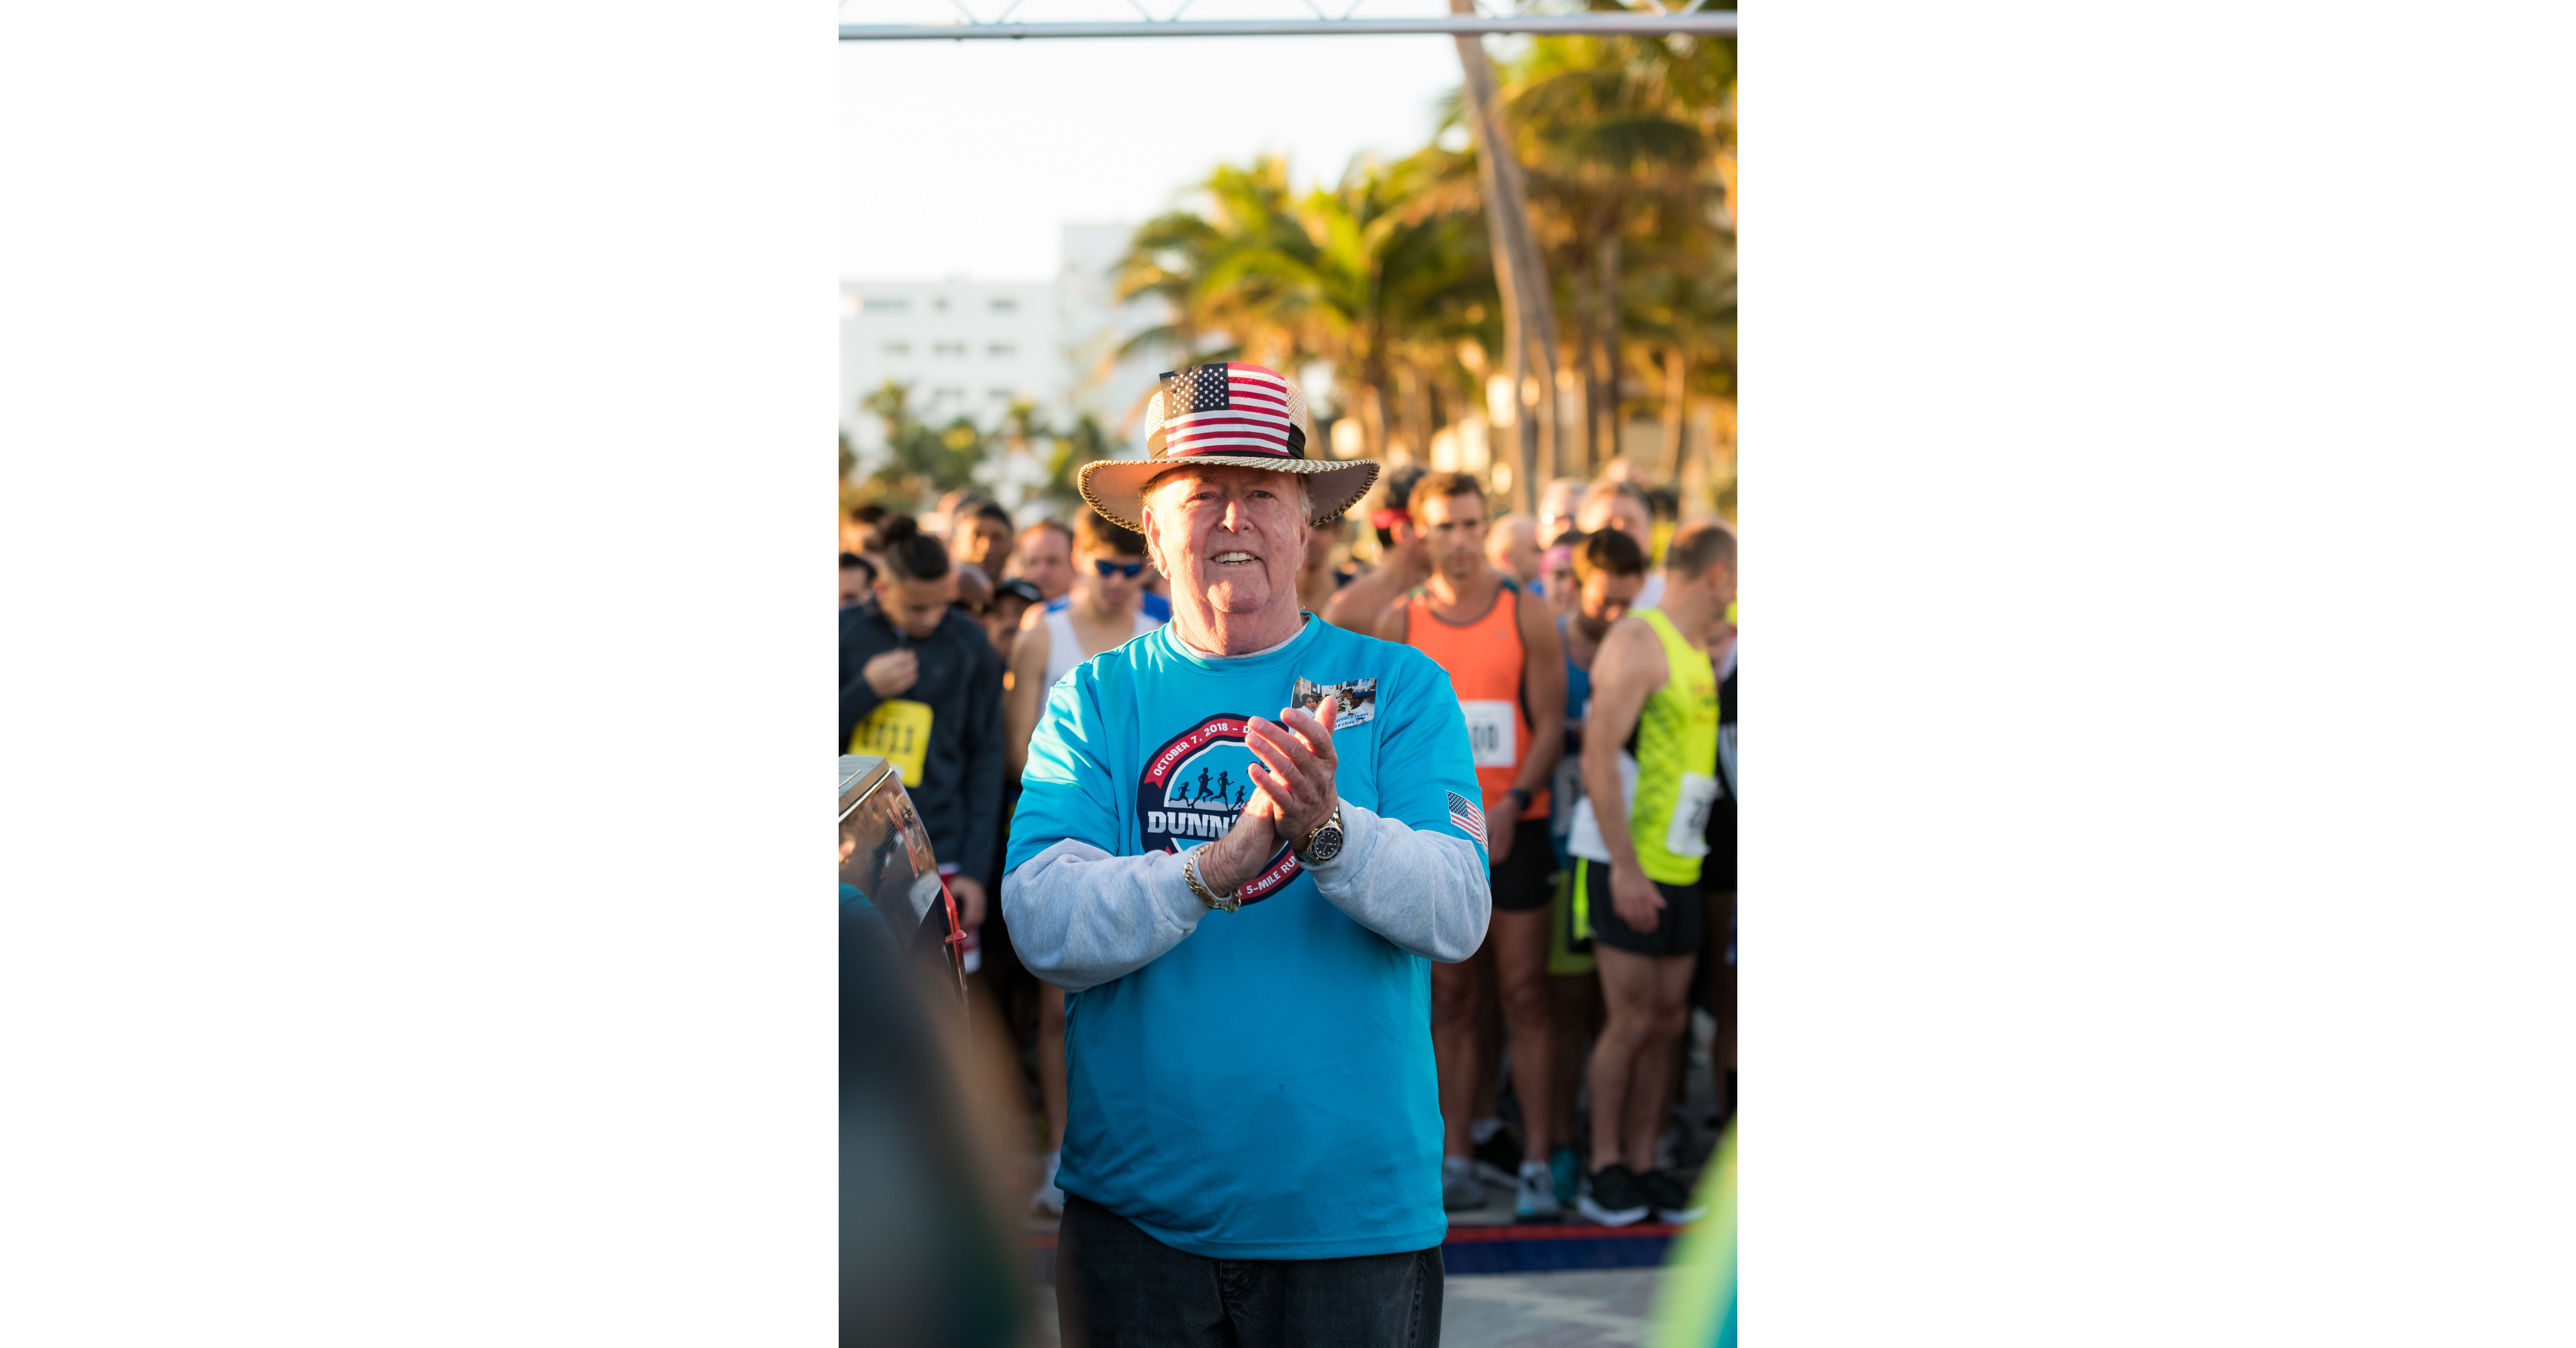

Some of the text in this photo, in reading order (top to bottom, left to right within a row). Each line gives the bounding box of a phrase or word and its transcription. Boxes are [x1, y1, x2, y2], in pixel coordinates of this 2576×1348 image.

[1153, 741, 1190, 776] OCTOBER
[1190, 735, 1202, 744] 7,
[1204, 723, 1228, 737] 2018
[1147, 811, 1240, 839] DUNN'
[1246, 871, 1281, 895] 5-MILE
